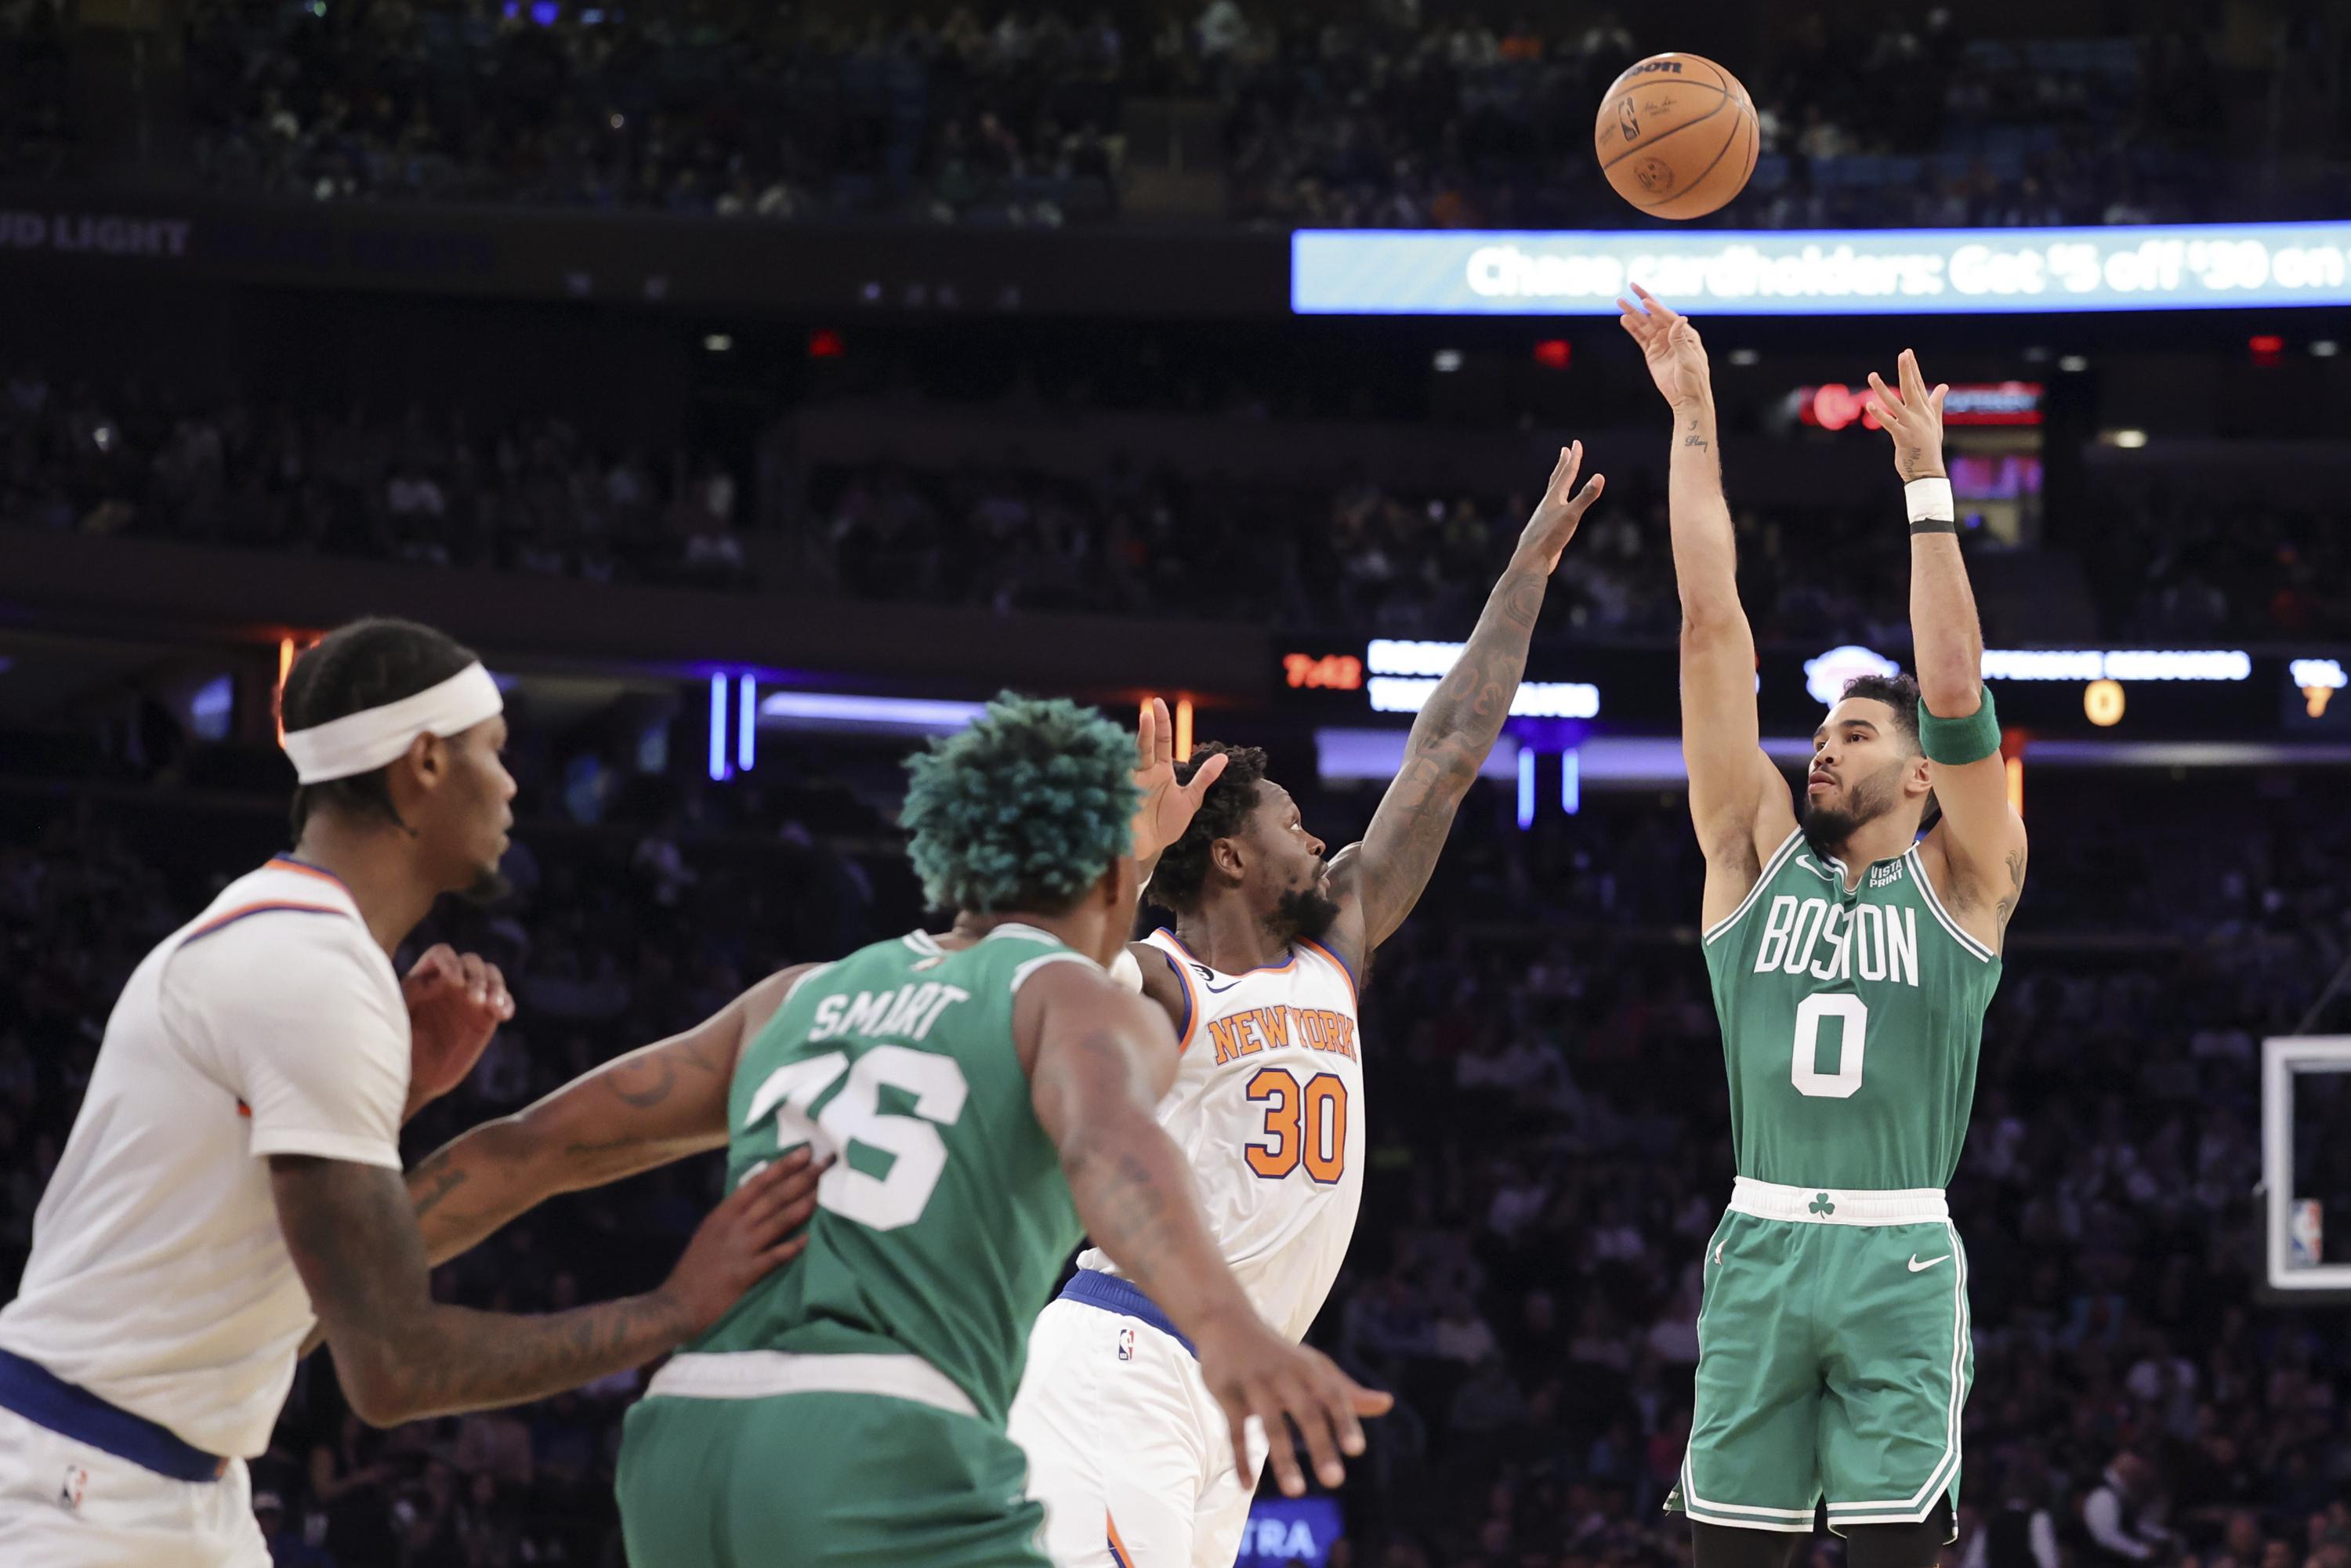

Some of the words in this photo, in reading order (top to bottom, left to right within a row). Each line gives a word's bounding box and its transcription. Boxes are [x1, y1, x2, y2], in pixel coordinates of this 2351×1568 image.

[52, 213, 190, 256] LIGHT
[1627, 246, 1943, 295] cardholders:
[1950, 245, 2045, 294] Get
[2105, 241, 2185, 291] off
[2273, 247, 2345, 288] on
[2084, 679, 2125, 726] 0
[1869, 868, 1903, 888] PRINT
[1871, 859, 1903, 878] VISTA
[1754, 895, 1918, 987] BOSTON
[807, 982, 971, 1041] SMART
[1208, 1005, 1290, 1066] NEW
[1287, 1005, 1357, 1066] YORK
[1791, 992, 1868, 1099] 0
[1244, 1067, 1348, 1185] 30
